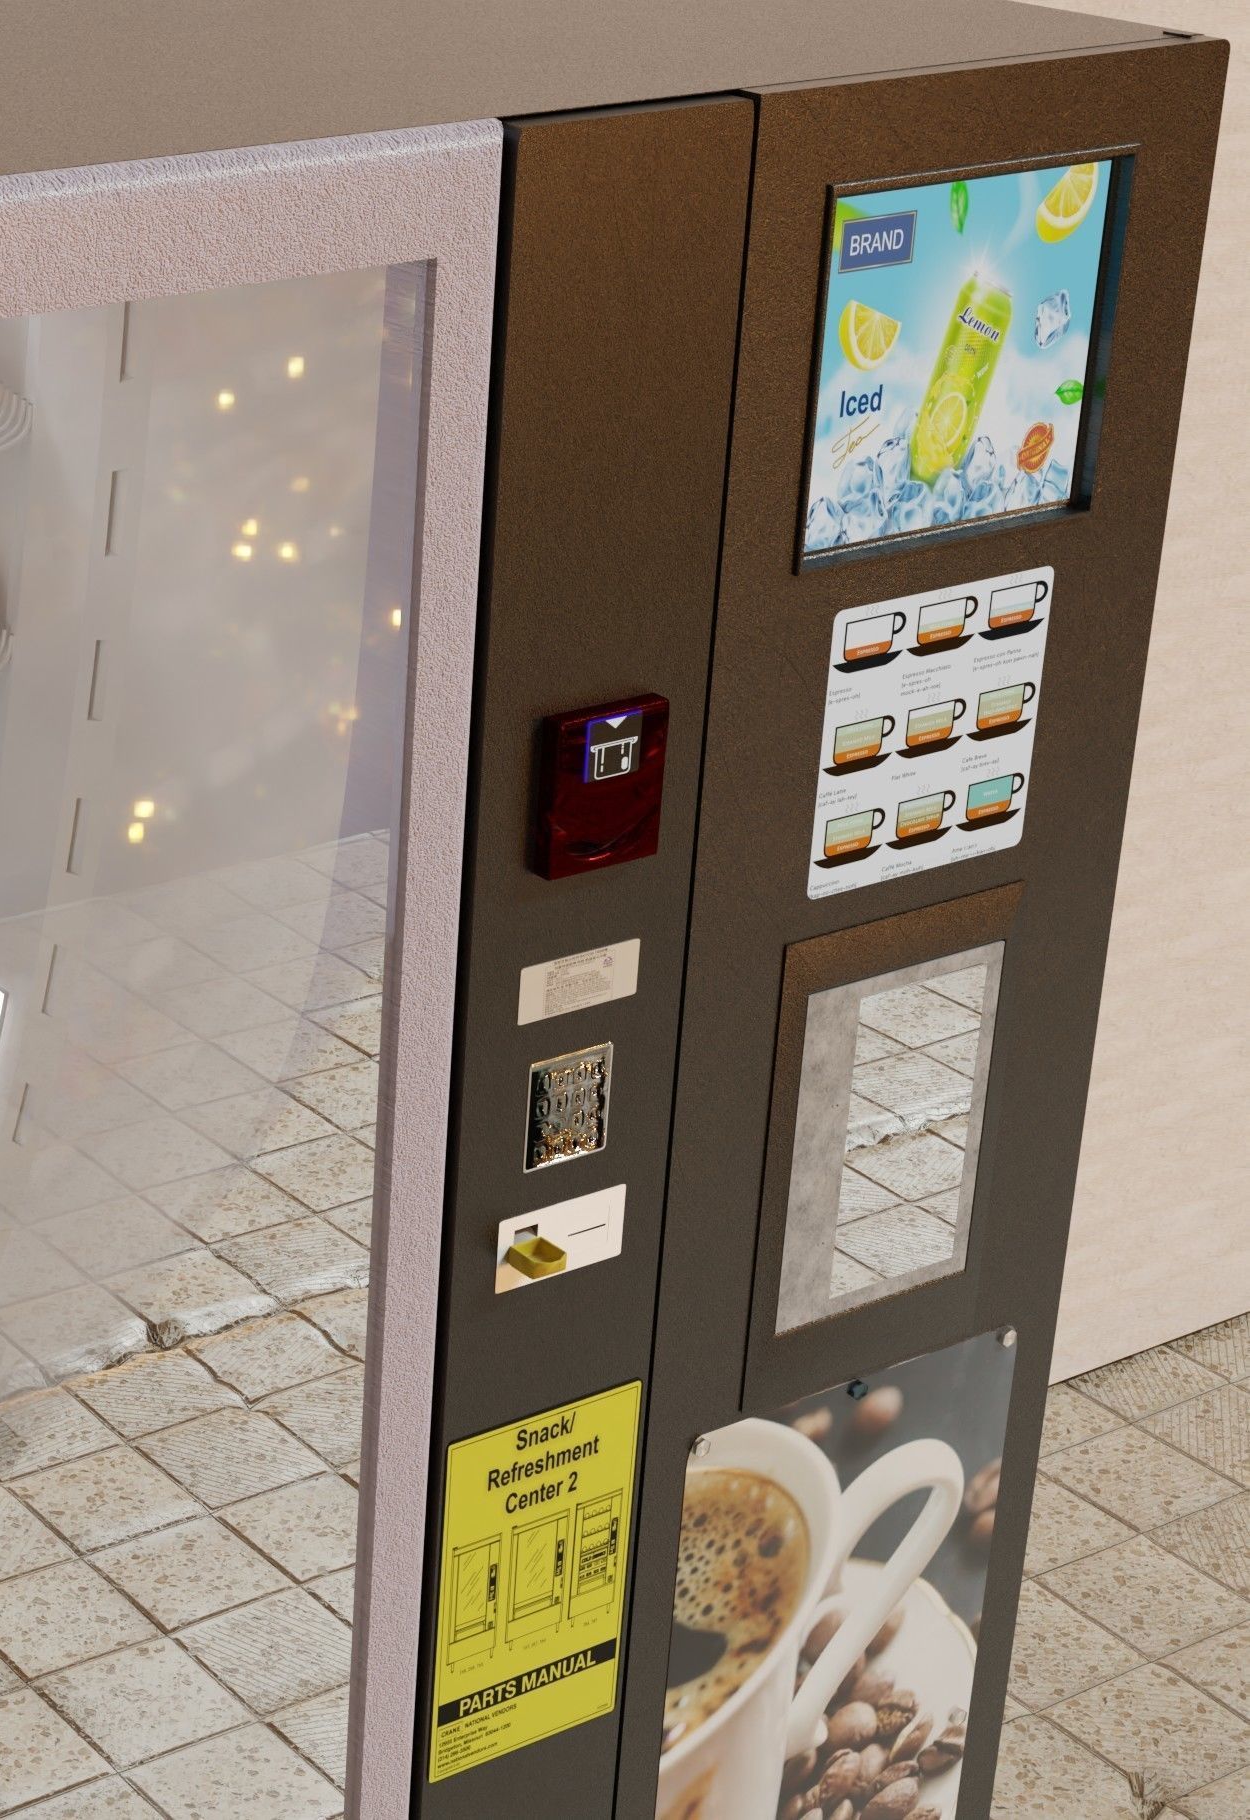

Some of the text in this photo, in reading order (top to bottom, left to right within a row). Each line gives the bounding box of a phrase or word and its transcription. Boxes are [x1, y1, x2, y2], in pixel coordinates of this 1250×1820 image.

[850, 228, 904, 257] BRAND
[958, 306, 1000, 341] Lemon
[839, 384, 884, 418] Iced
[516, 1411, 576, 1451] Snack/
[487, 1434, 600, 1492] Refreshment
[505, 1470, 578, 1514] Center 2
[459, 1650, 597, 1717] PARTS MANUAL
[441, 1703, 517, 1738] CRANE NATIONAL VENDORS
